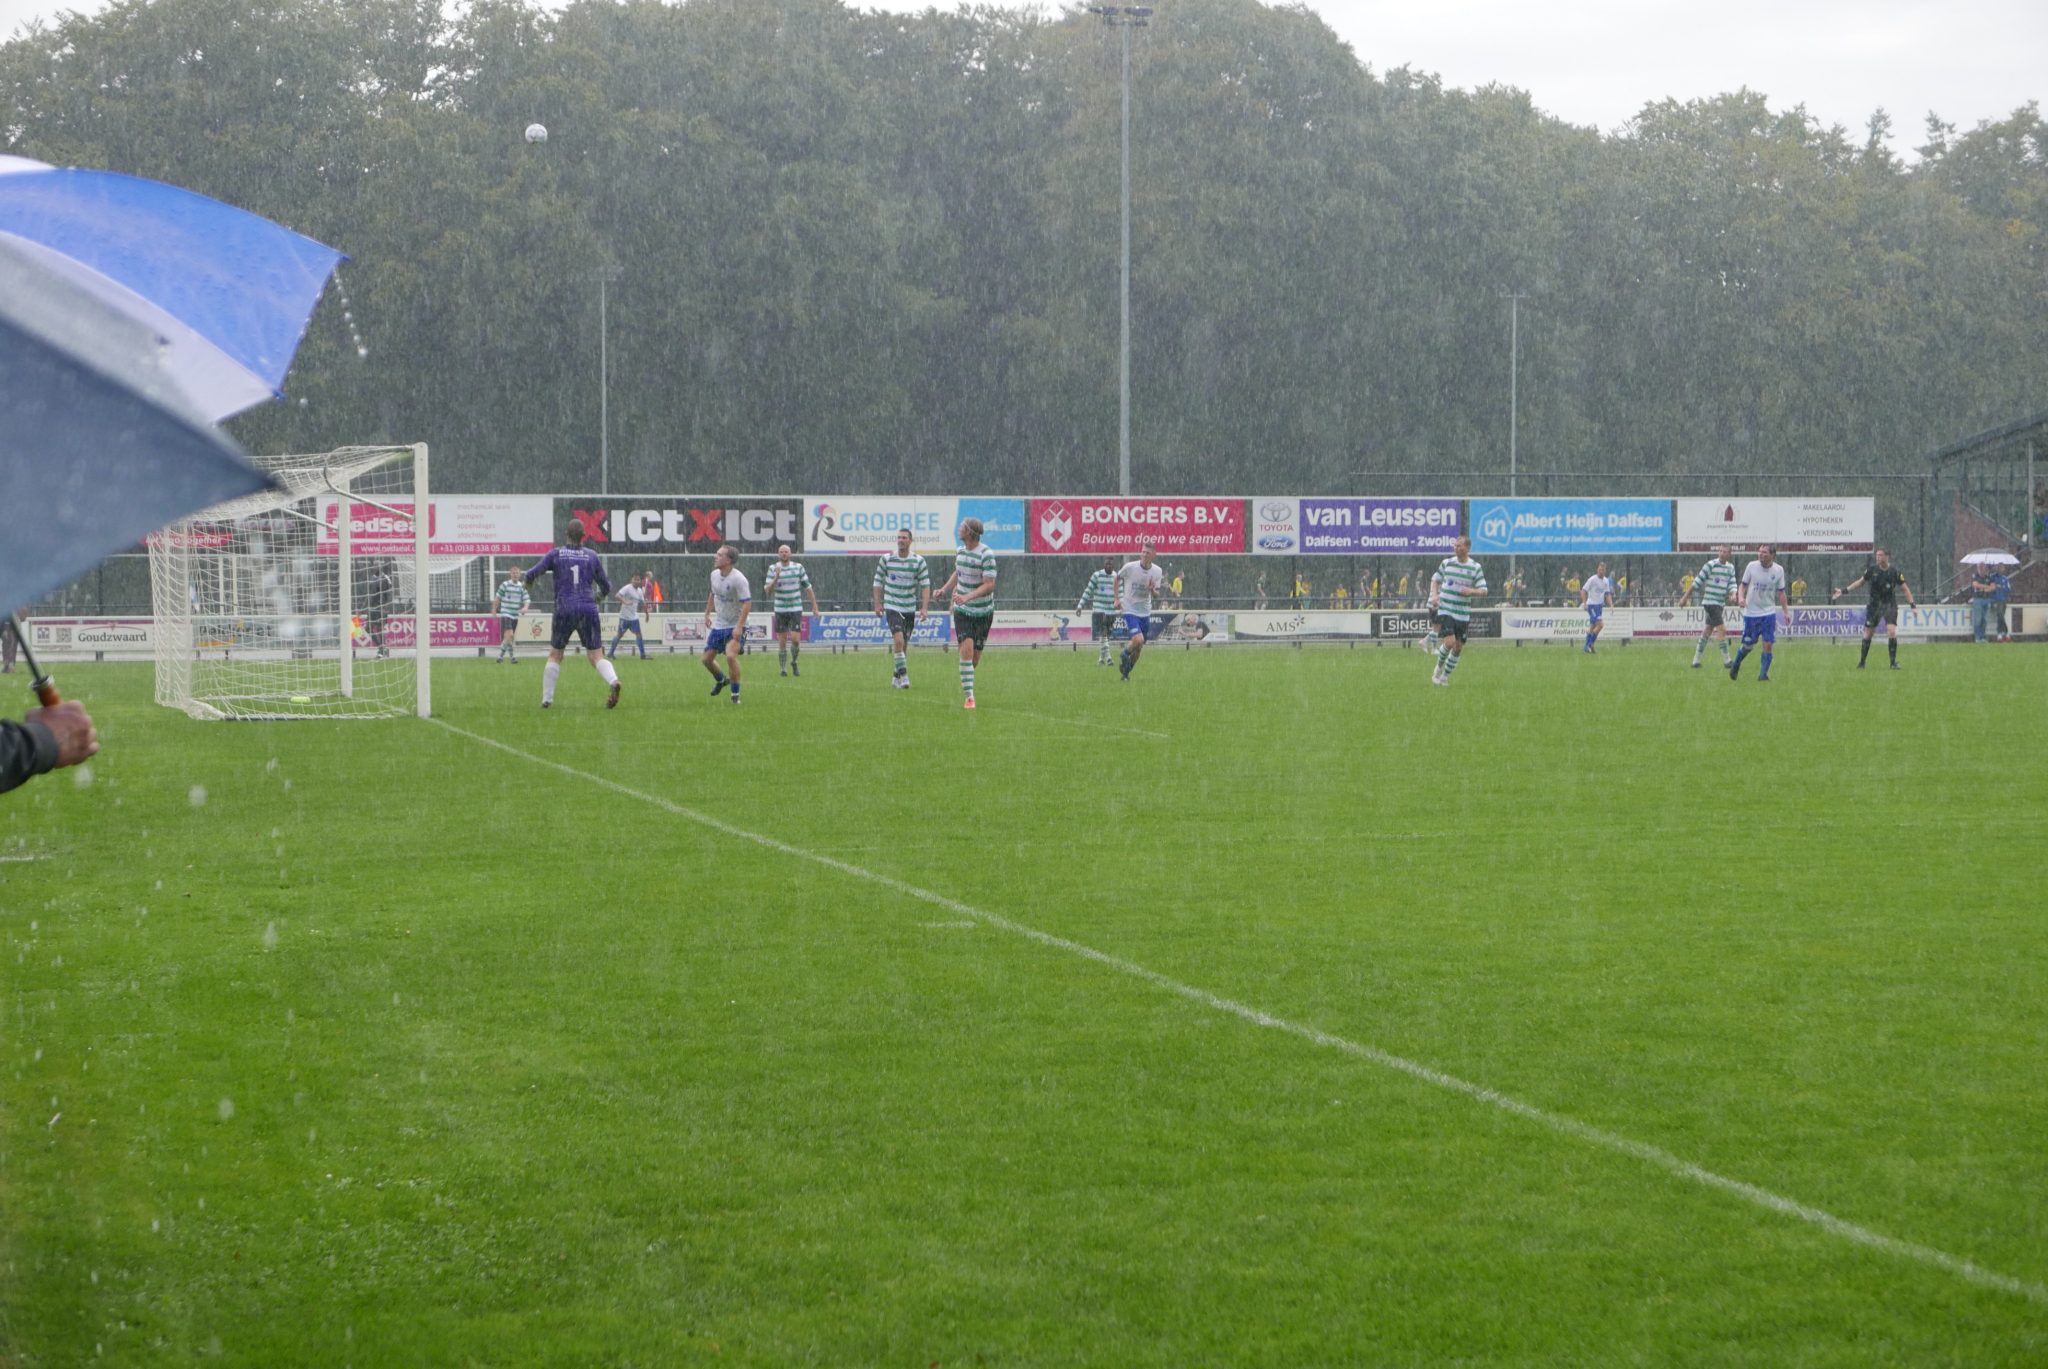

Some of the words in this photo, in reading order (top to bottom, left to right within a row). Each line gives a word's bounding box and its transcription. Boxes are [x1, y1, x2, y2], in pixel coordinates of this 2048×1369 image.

[1081, 506, 1188, 524] BONGERS
[1194, 507, 1233, 524] B.V.
[1359, 506, 1457, 526] Leussen
[840, 512, 940, 531] GROBBEE
[1515, 513, 1562, 528] Albert
[1566, 513, 1604, 531] Heijn
[1608, 513, 1663, 528] Dalfsen
[1259, 524, 1294, 532] TOYOTA
[1082, 533, 1131, 544] Bouwen
[1134, 533, 1164, 544] doen
[1168, 536, 1185, 544] we
[1188, 533, 1233, 544] samen!
[1263, 537, 1289, 548] Ford
[1305, 535, 1351, 547] Dalfsen
[1361, 536, 1408, 547] Ommen
[440, 544, 453, 553] +31
[475, 544, 489, 553] 338
[502, 544, 512, 553] 31
[570, 564, 579, 585] 1
[820, 615, 881, 626] Laarman
[1687, 609, 1745, 622] HUMAN
[1799, 609, 1849, 621] ZWOLSE
[384, 620, 458, 633] ONERS
[462, 620, 489, 633] B.V.
[1266, 622, 1296, 632] AMS
[1778, 625, 1865, 635] STEENHOUWER
[78, 631, 147, 642] Goudzwaard
[823, 629, 840, 638] en
[845, 627, 939, 640] Sneltraport
